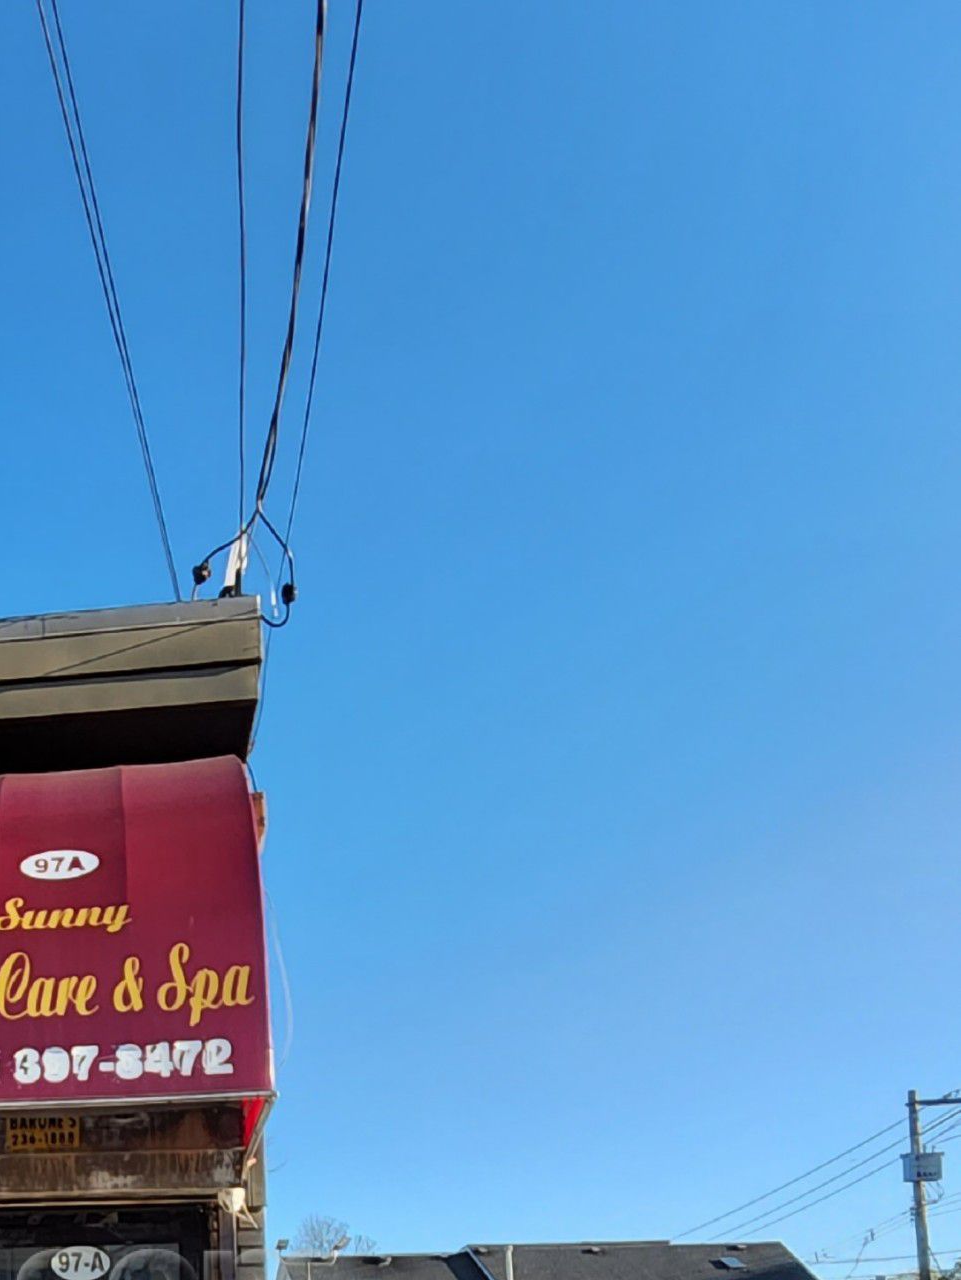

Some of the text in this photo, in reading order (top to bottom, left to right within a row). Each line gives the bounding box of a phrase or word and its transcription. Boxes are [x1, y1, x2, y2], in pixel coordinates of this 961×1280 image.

[34, 856, 86, 874] 97A
[113, 956, 145, 1013] &
[158, 942, 256, 1027] Spa
[57, 1251, 105, 1273] 97-A
